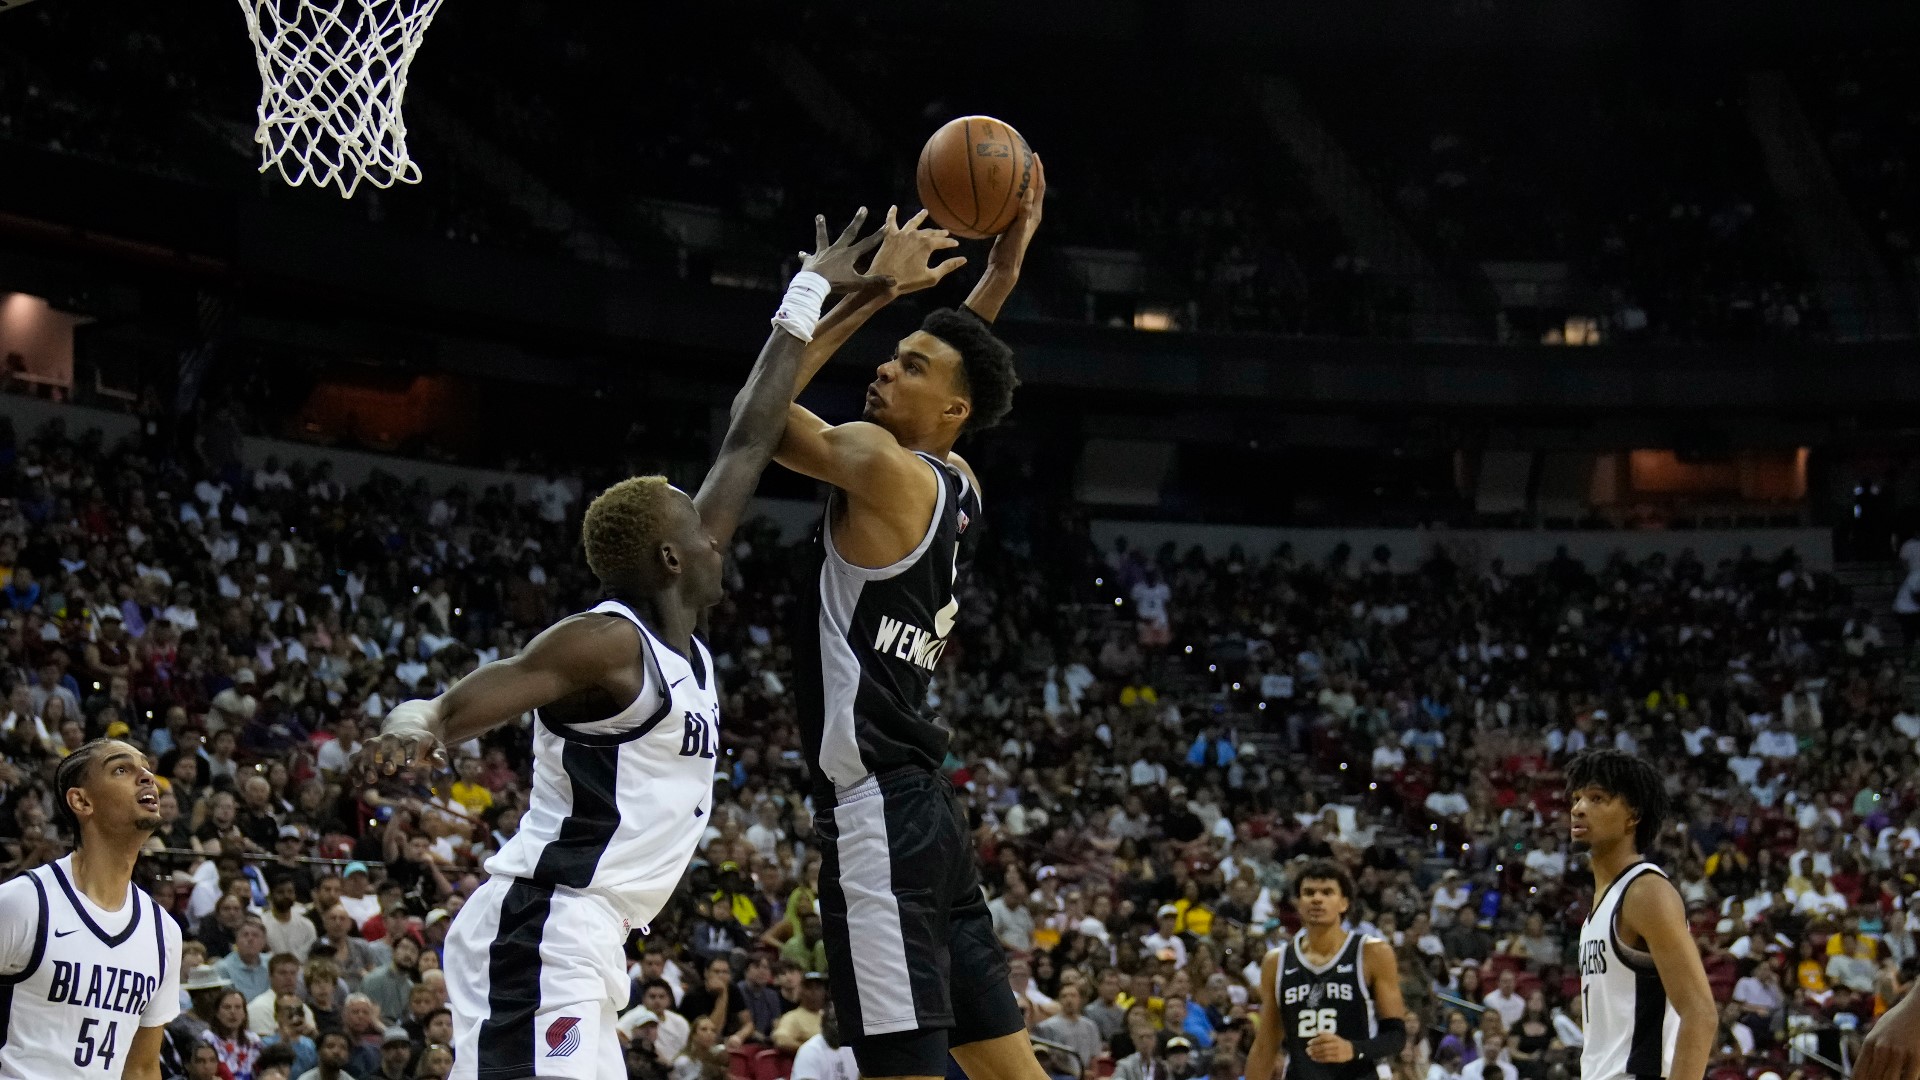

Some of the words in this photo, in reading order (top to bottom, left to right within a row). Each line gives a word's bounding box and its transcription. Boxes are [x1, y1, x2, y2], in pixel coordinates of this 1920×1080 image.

[47, 959, 157, 1016] BLAZERS
[73, 1017, 118, 1071] 54
[1298, 1008, 1338, 1038] 26
